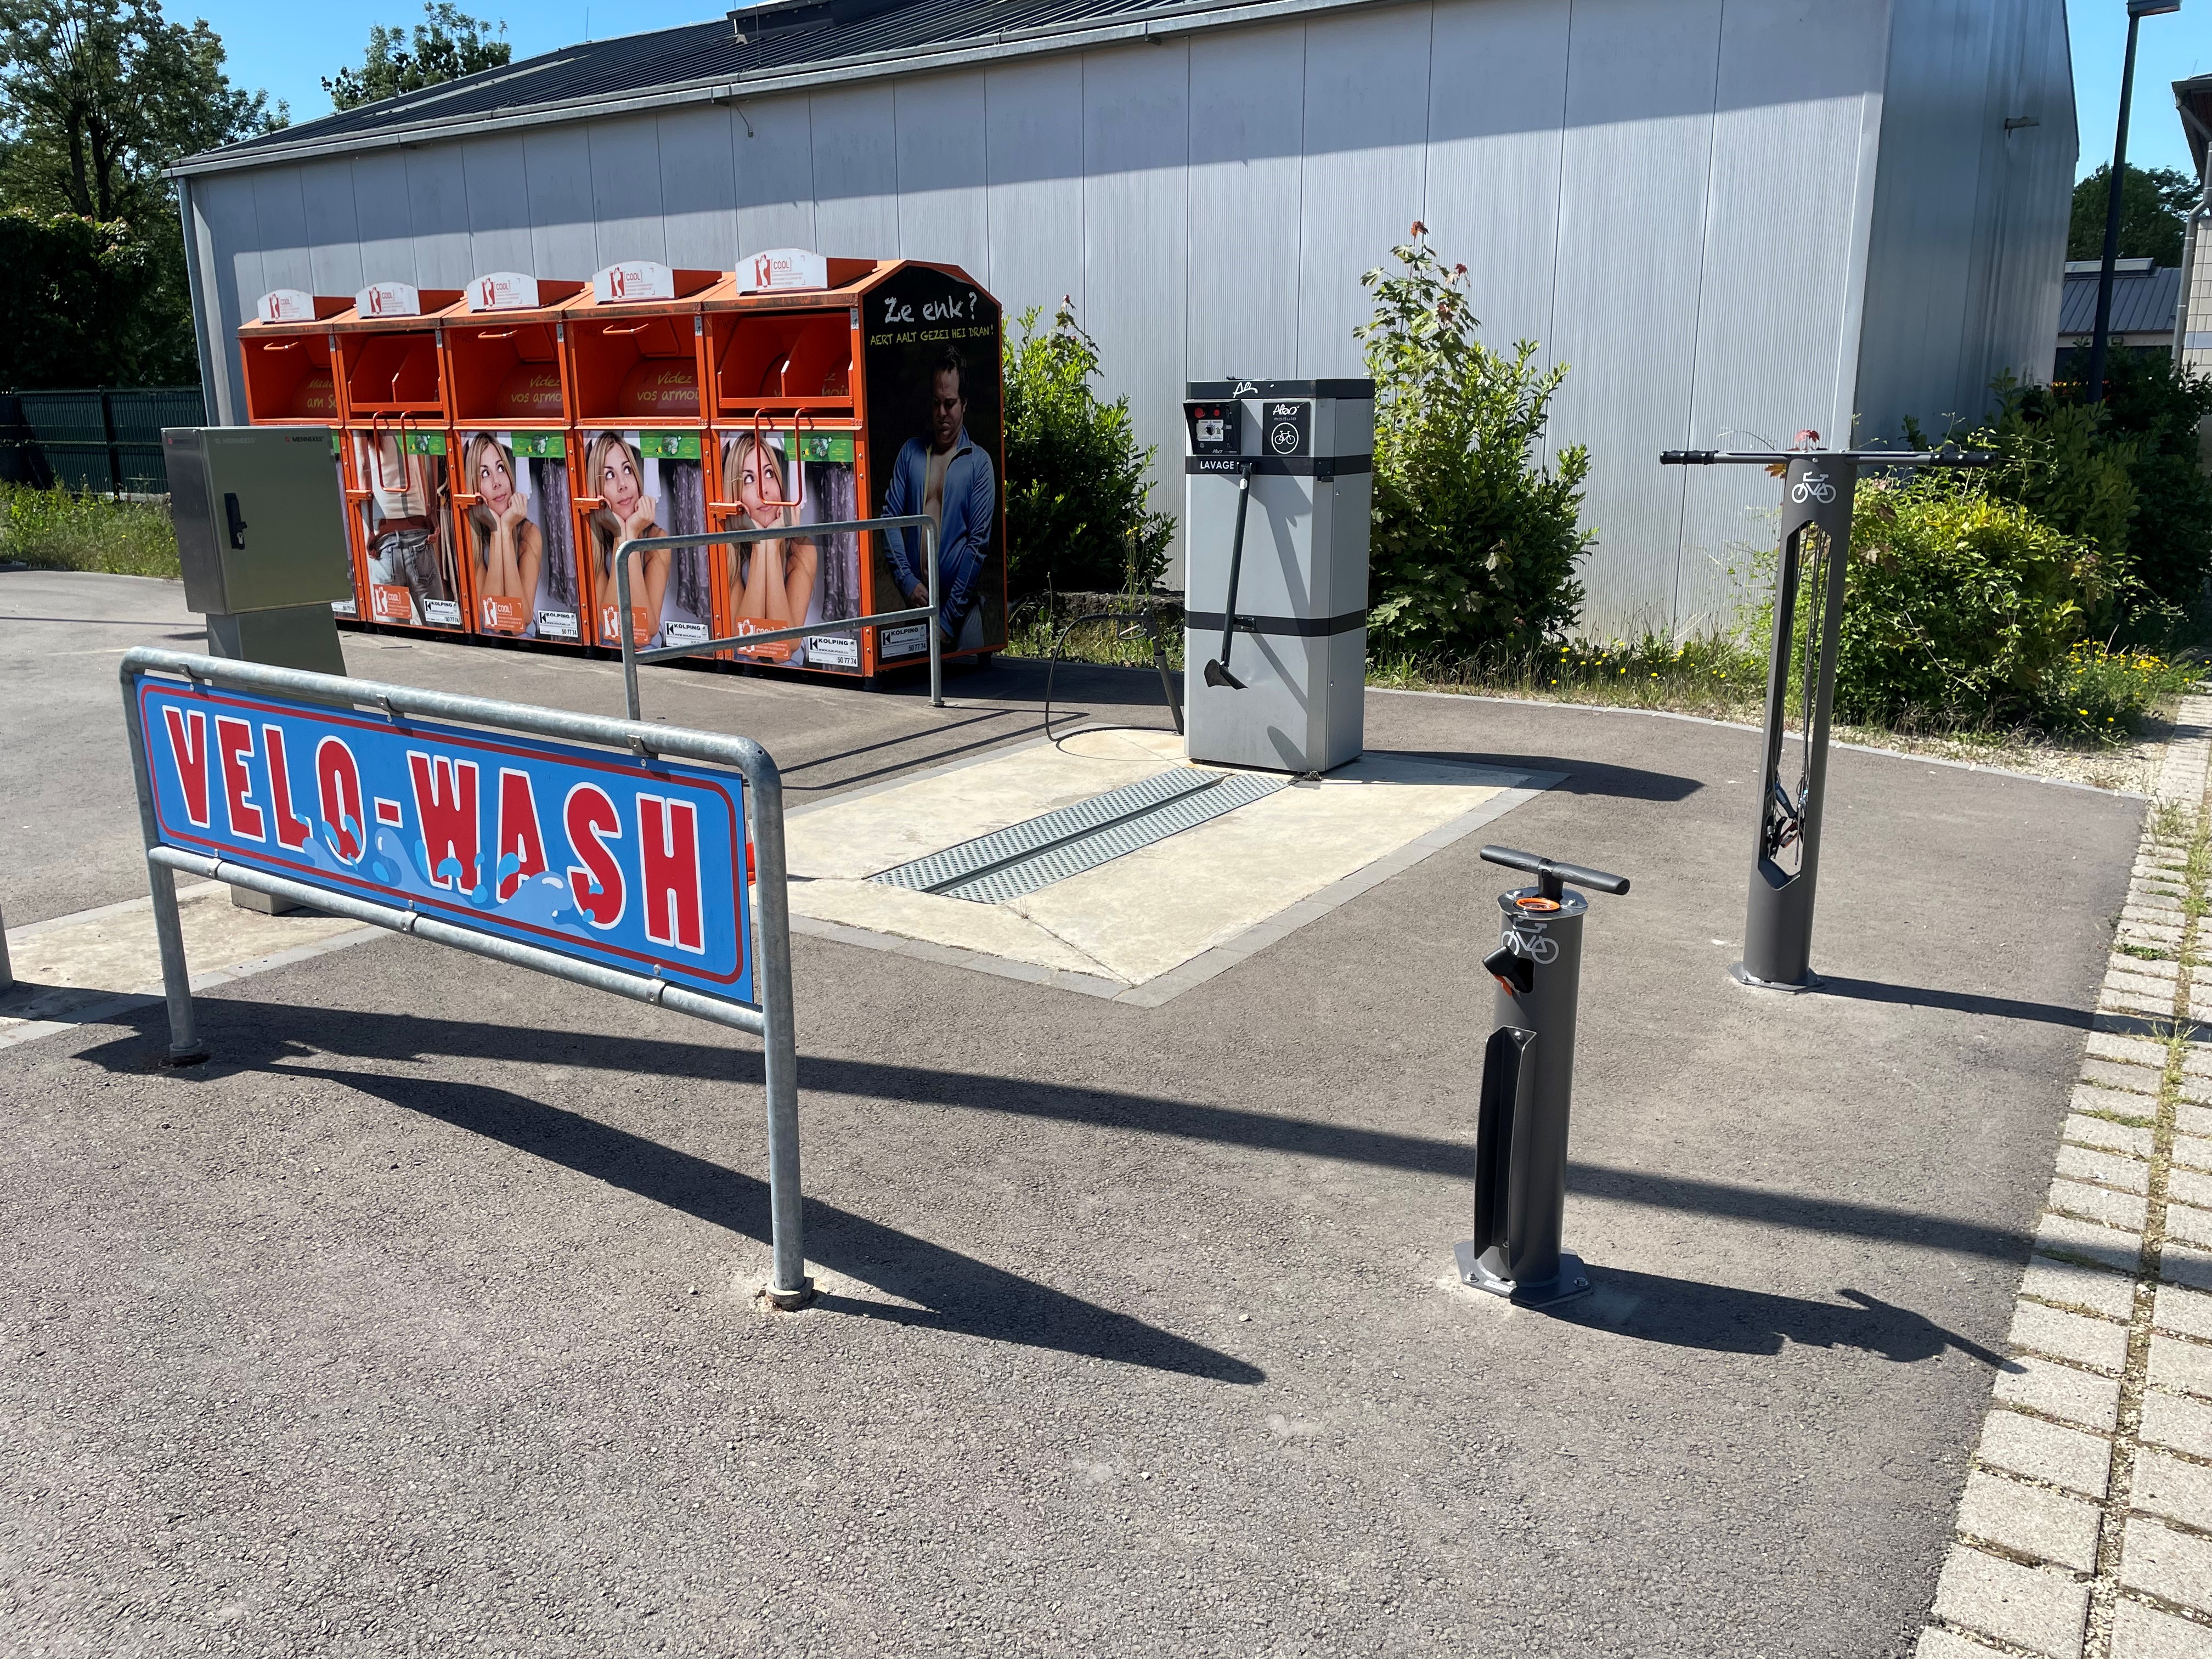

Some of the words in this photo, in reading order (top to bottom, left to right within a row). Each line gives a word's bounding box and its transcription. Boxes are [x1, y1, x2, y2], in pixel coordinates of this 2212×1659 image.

[774, 261, 789, 269] COOL
[626, 273, 640, 281] COOL
[884, 296, 915, 323] Ze
[870, 333, 894, 345] AERT
[896, 331, 917, 343] AALT
[920, 330, 950, 341] GEZEI
[952, 328, 967, 338] HEI
[529, 374, 560, 387] Videz
[658, 371, 692, 385] Videz
[511, 393, 529, 403] vos
[533, 393, 562, 403] armo
[637, 391, 657, 401] vos
[662, 387, 699, 401] armoi
[1200, 461, 1234, 470] LAVAGE
[498, 604, 510, 613] COOL
[891, 627, 919, 636] KOLPING
[161, 704, 706, 955] VELO-WASH
